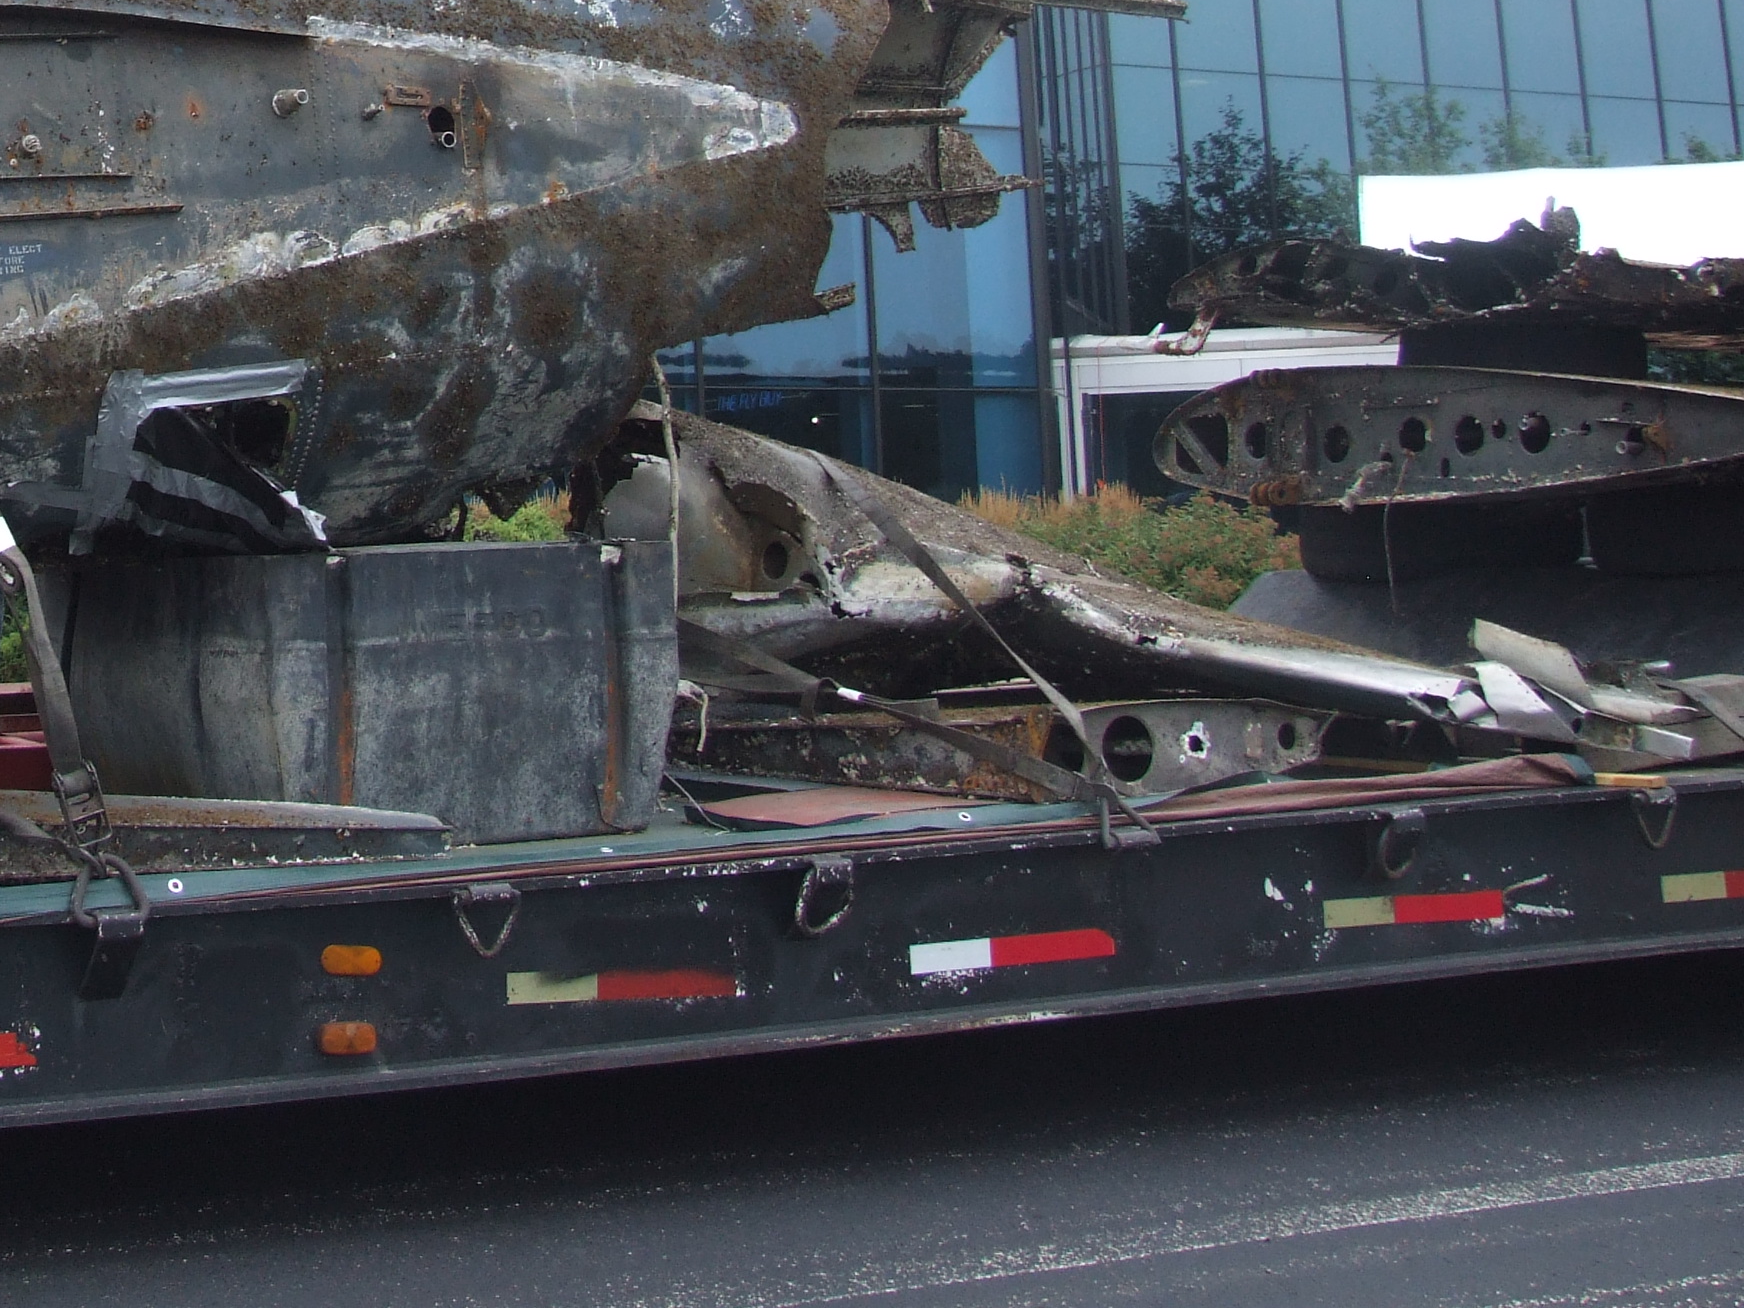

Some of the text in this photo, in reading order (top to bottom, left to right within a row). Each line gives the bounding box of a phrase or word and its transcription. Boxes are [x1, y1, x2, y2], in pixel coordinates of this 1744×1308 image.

[8, 244, 43, 255] ELECT
[718, 395, 738, 411] THE
[740, 393, 758, 409] FLY
